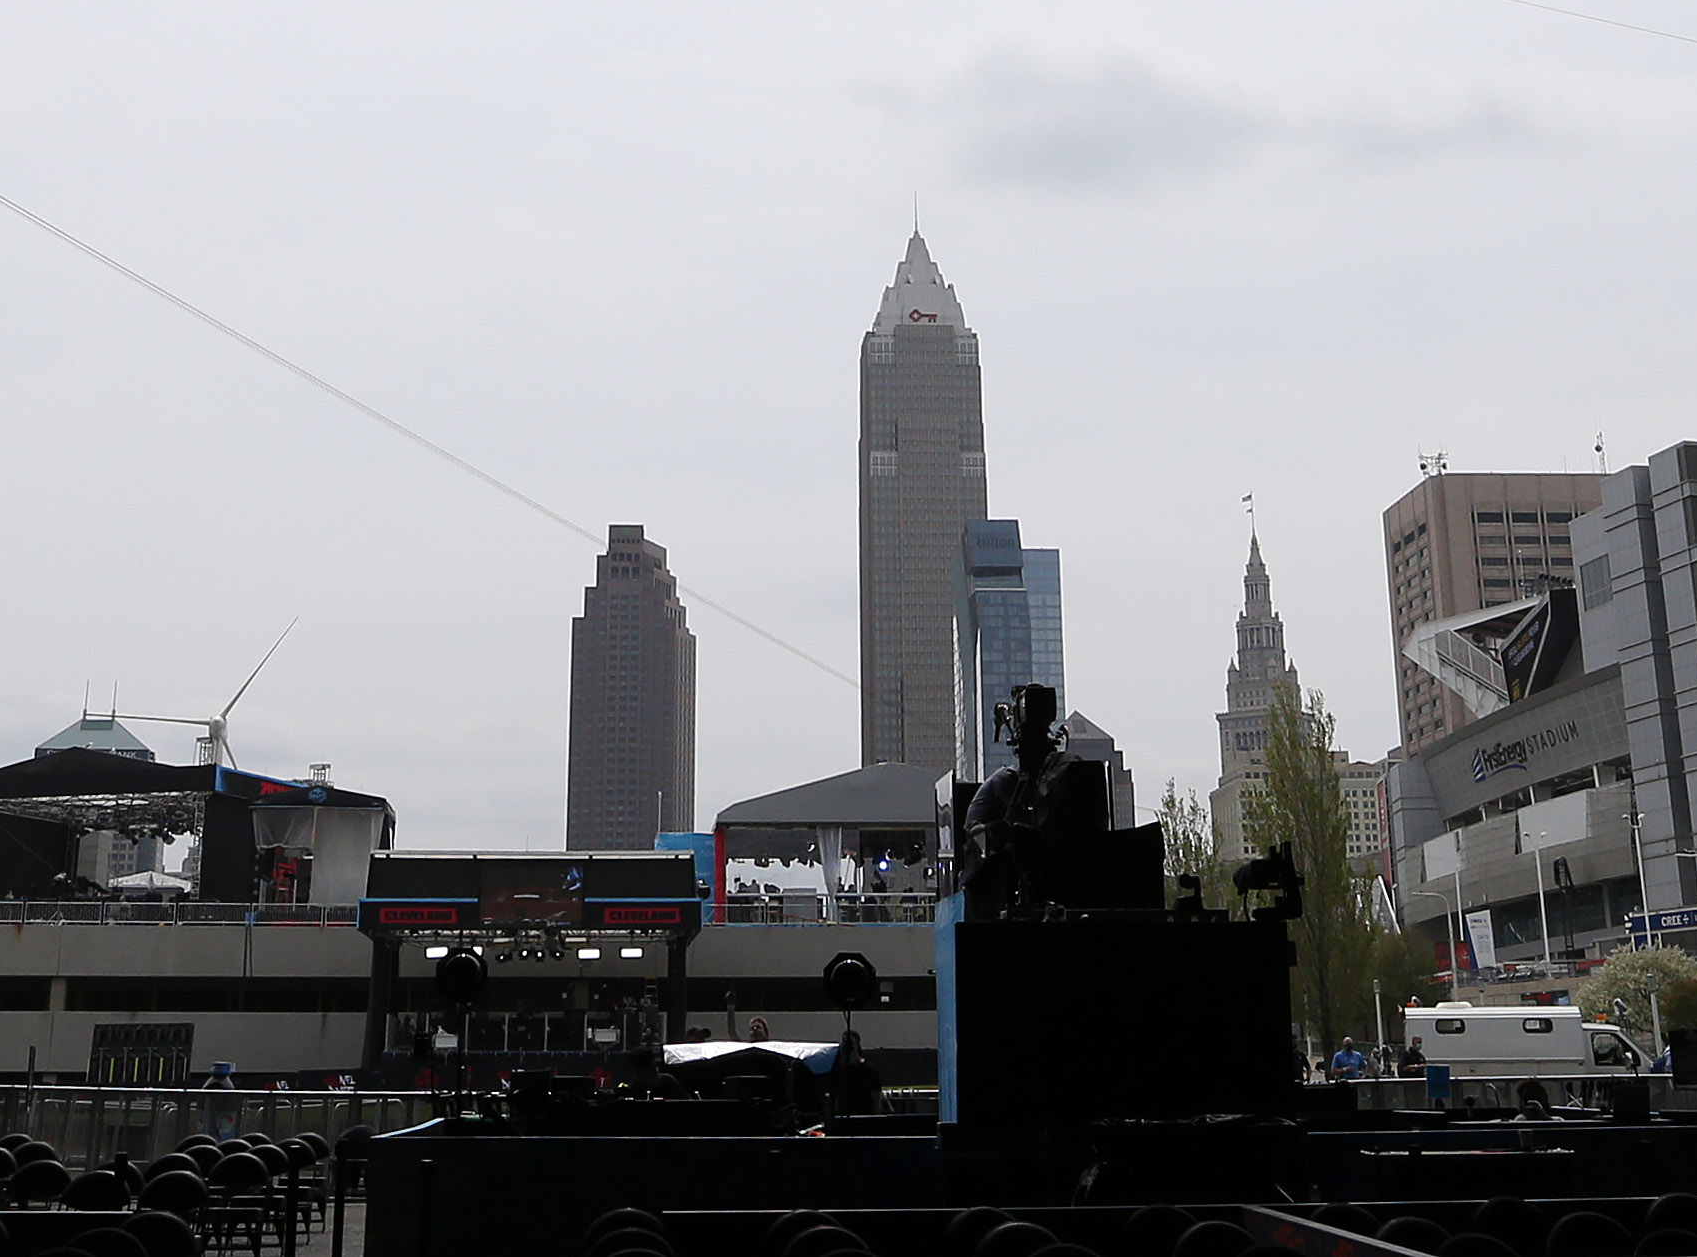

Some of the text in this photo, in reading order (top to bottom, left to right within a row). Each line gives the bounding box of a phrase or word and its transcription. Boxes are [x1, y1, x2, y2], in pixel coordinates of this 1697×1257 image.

[1481, 720, 1580, 773] FirstEnergy STADIUM
[384, 909, 454, 923] CLEVELAND
[608, 909, 677, 922] CLEVELAND
[1661, 915, 1683, 927] CREE
